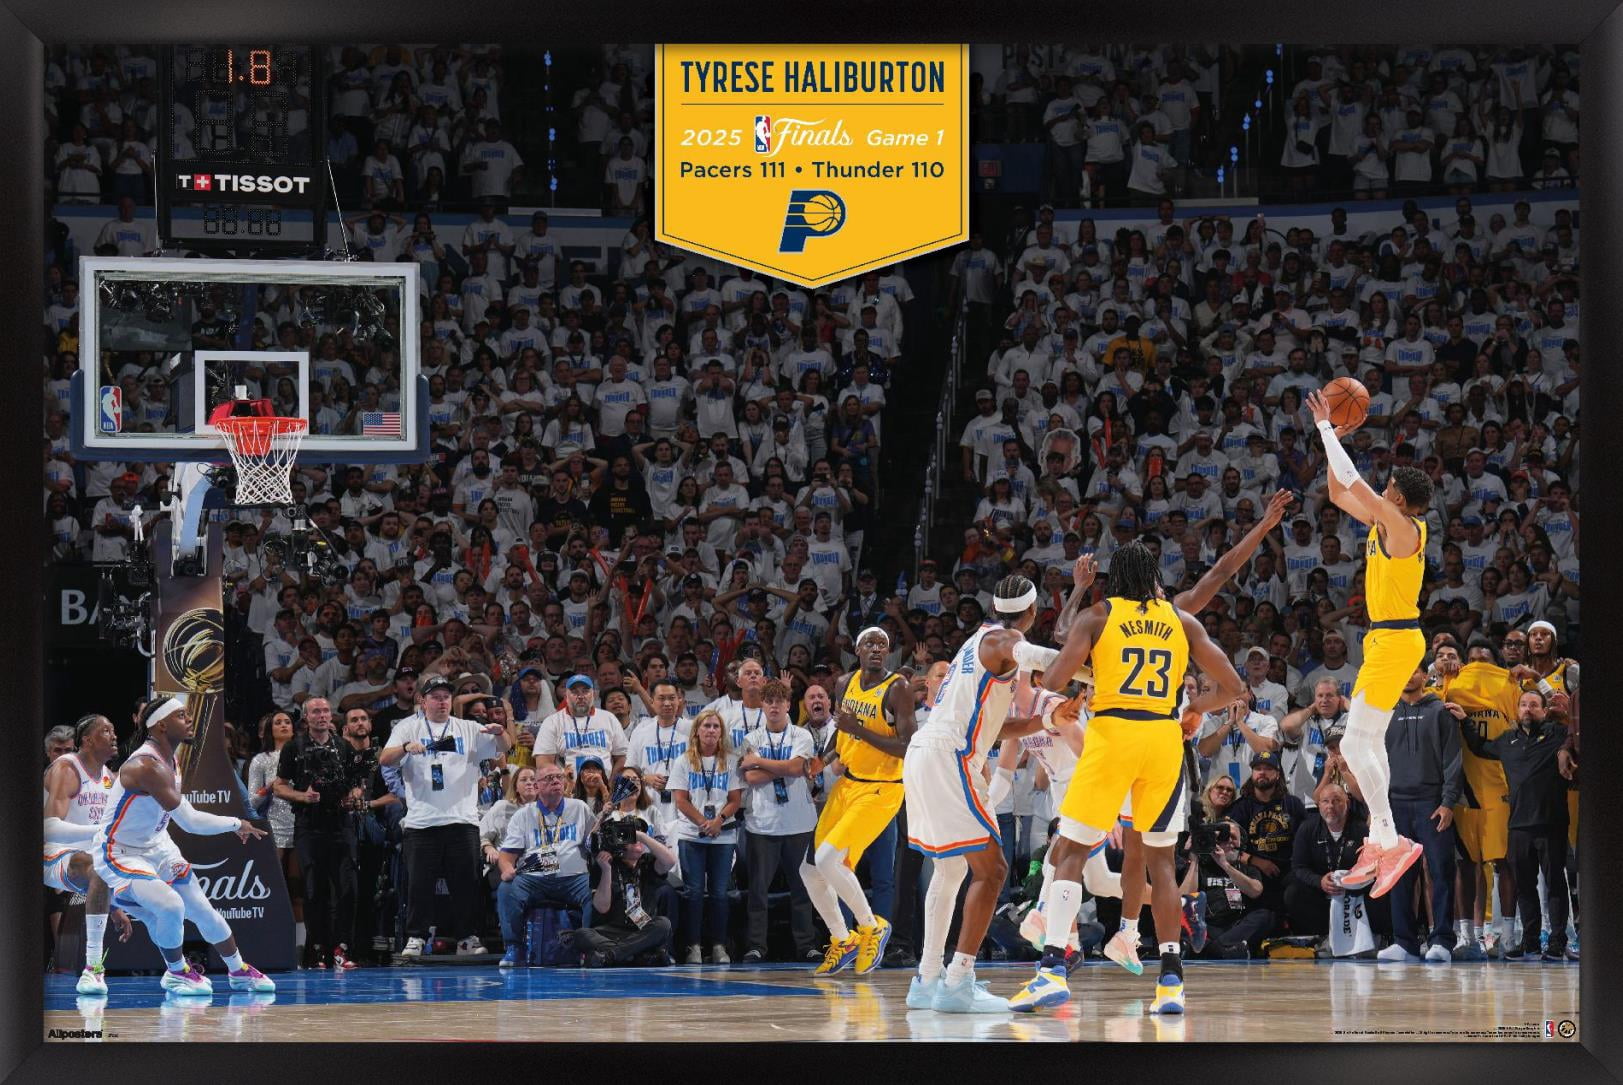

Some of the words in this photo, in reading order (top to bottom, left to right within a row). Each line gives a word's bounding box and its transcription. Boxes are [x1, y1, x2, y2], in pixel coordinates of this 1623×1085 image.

[227, 48, 272, 85] 1.8
[680, 61, 775, 93] TYRESE
[784, 61, 945, 93] HALIBURTON
[680, 129, 743, 147] 2025
[763, 117, 853, 158] Finals
[866, 129, 929, 147] Game
[936, 129, 944, 146] 1
[680, 161, 752, 178] Pacers
[760, 161, 786, 178] 111
[811, 161, 904, 178] Thunder
[911, 161, 945, 178] 110
[214, 174, 311, 194] TISSOT
[1119, 619, 1174, 641] NESMITH
[1119, 647, 1172, 699] 23
[217, 790, 231, 803] TV
[252, 907, 265, 919] TV
